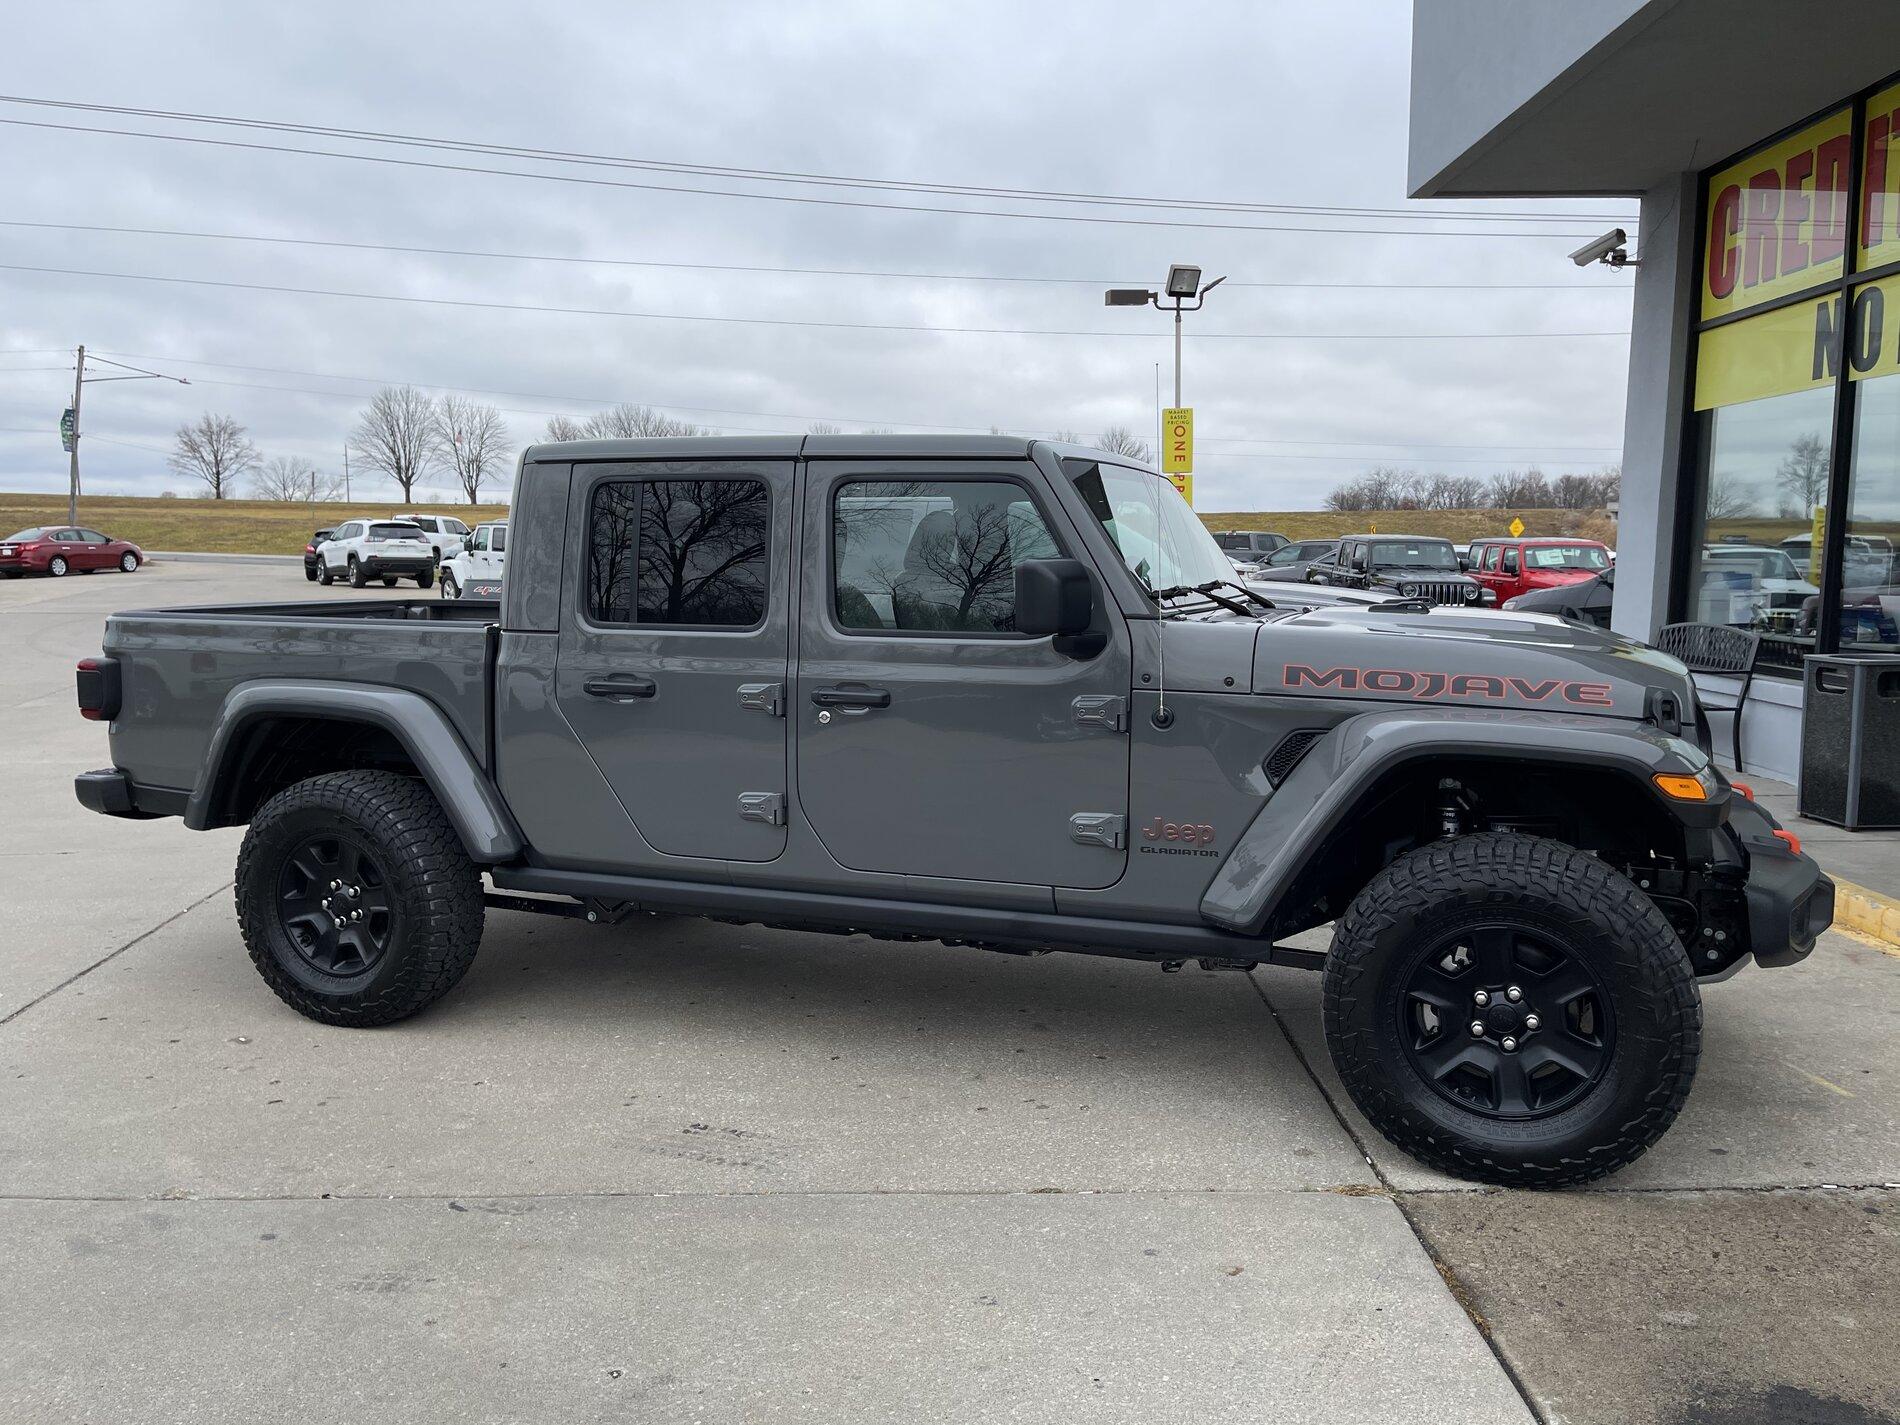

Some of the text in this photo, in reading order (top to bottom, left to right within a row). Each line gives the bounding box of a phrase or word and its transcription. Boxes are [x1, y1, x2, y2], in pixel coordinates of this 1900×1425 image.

[1709, 107, 1900, 299] CREDI
[1812, 286, 1884, 381] NO
[1174, 425, 1186, 462] ONE
[1283, 664, 1614, 707] MOJAVE
[1140, 846, 1220, 858] GLADIATOR
[1143, 816, 1215, 848] Jeep
